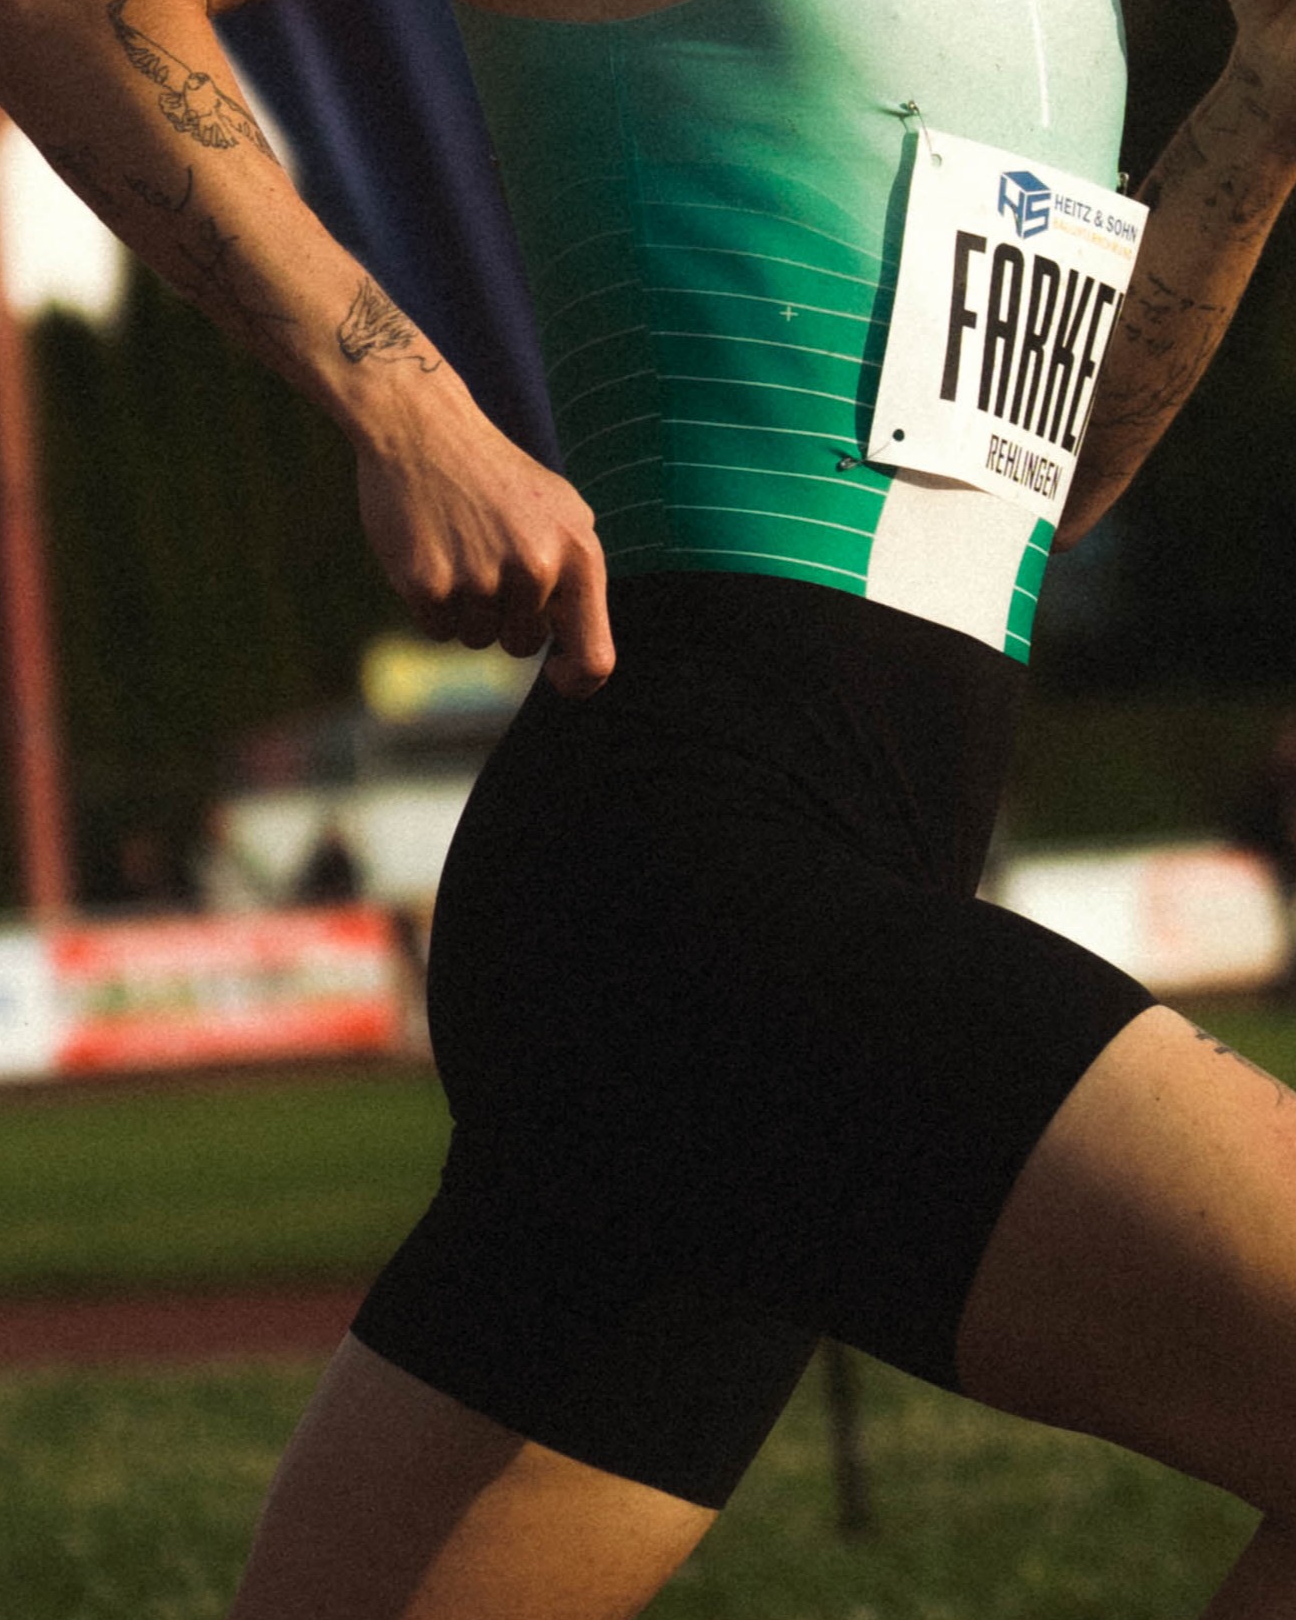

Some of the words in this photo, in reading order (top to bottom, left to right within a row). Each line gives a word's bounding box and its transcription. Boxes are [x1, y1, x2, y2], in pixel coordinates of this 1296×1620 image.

[1055, 194, 1092, 223] HEITZ
[1094, 210, 1104, 229] &
[1106, 215, 1139, 243] SOHN
[939, 230, 1124, 457] FARKE
[986, 434, 1063, 500] REHLINGEN
